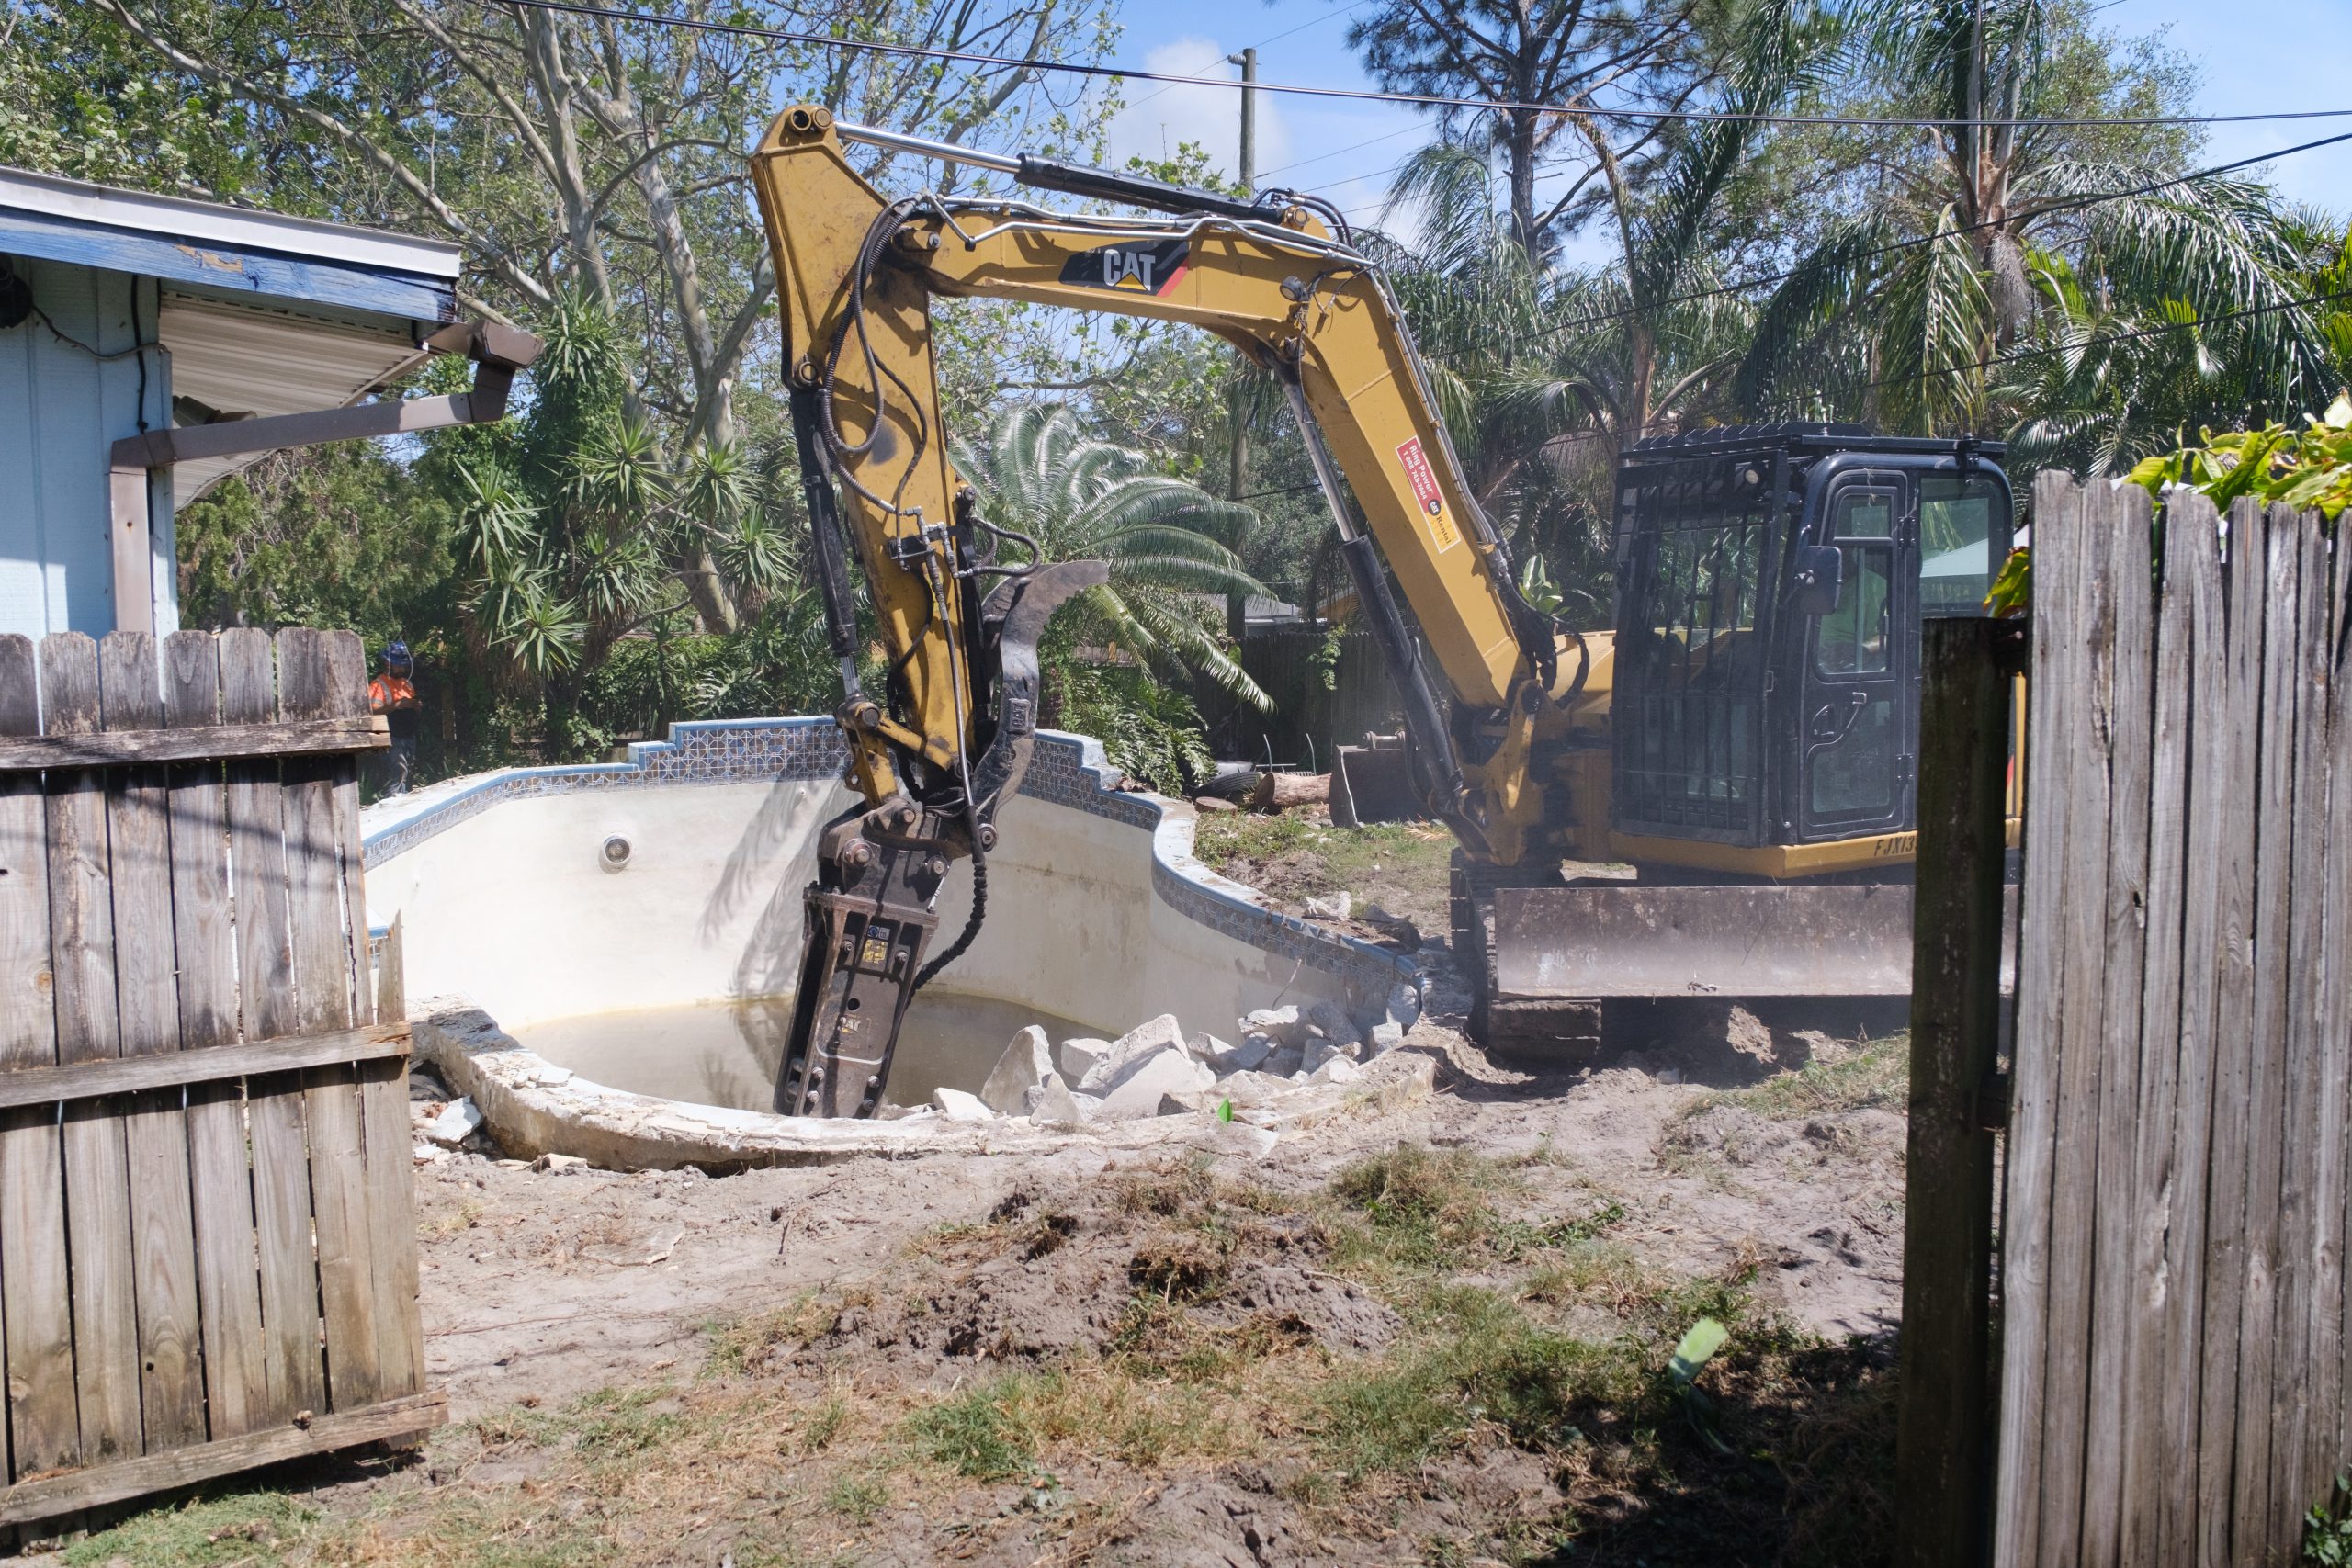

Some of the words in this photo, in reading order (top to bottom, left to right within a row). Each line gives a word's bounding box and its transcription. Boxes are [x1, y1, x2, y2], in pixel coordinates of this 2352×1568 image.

[1104, 248, 1156, 291] CAT
[1409, 445, 1421, 466] Ring
[1419, 464, 1433, 493] Power
[1430, 501, 1440, 513] CAT
[1437, 516, 1452, 544] Rental
[1874, 836, 1917, 856] FJX13
